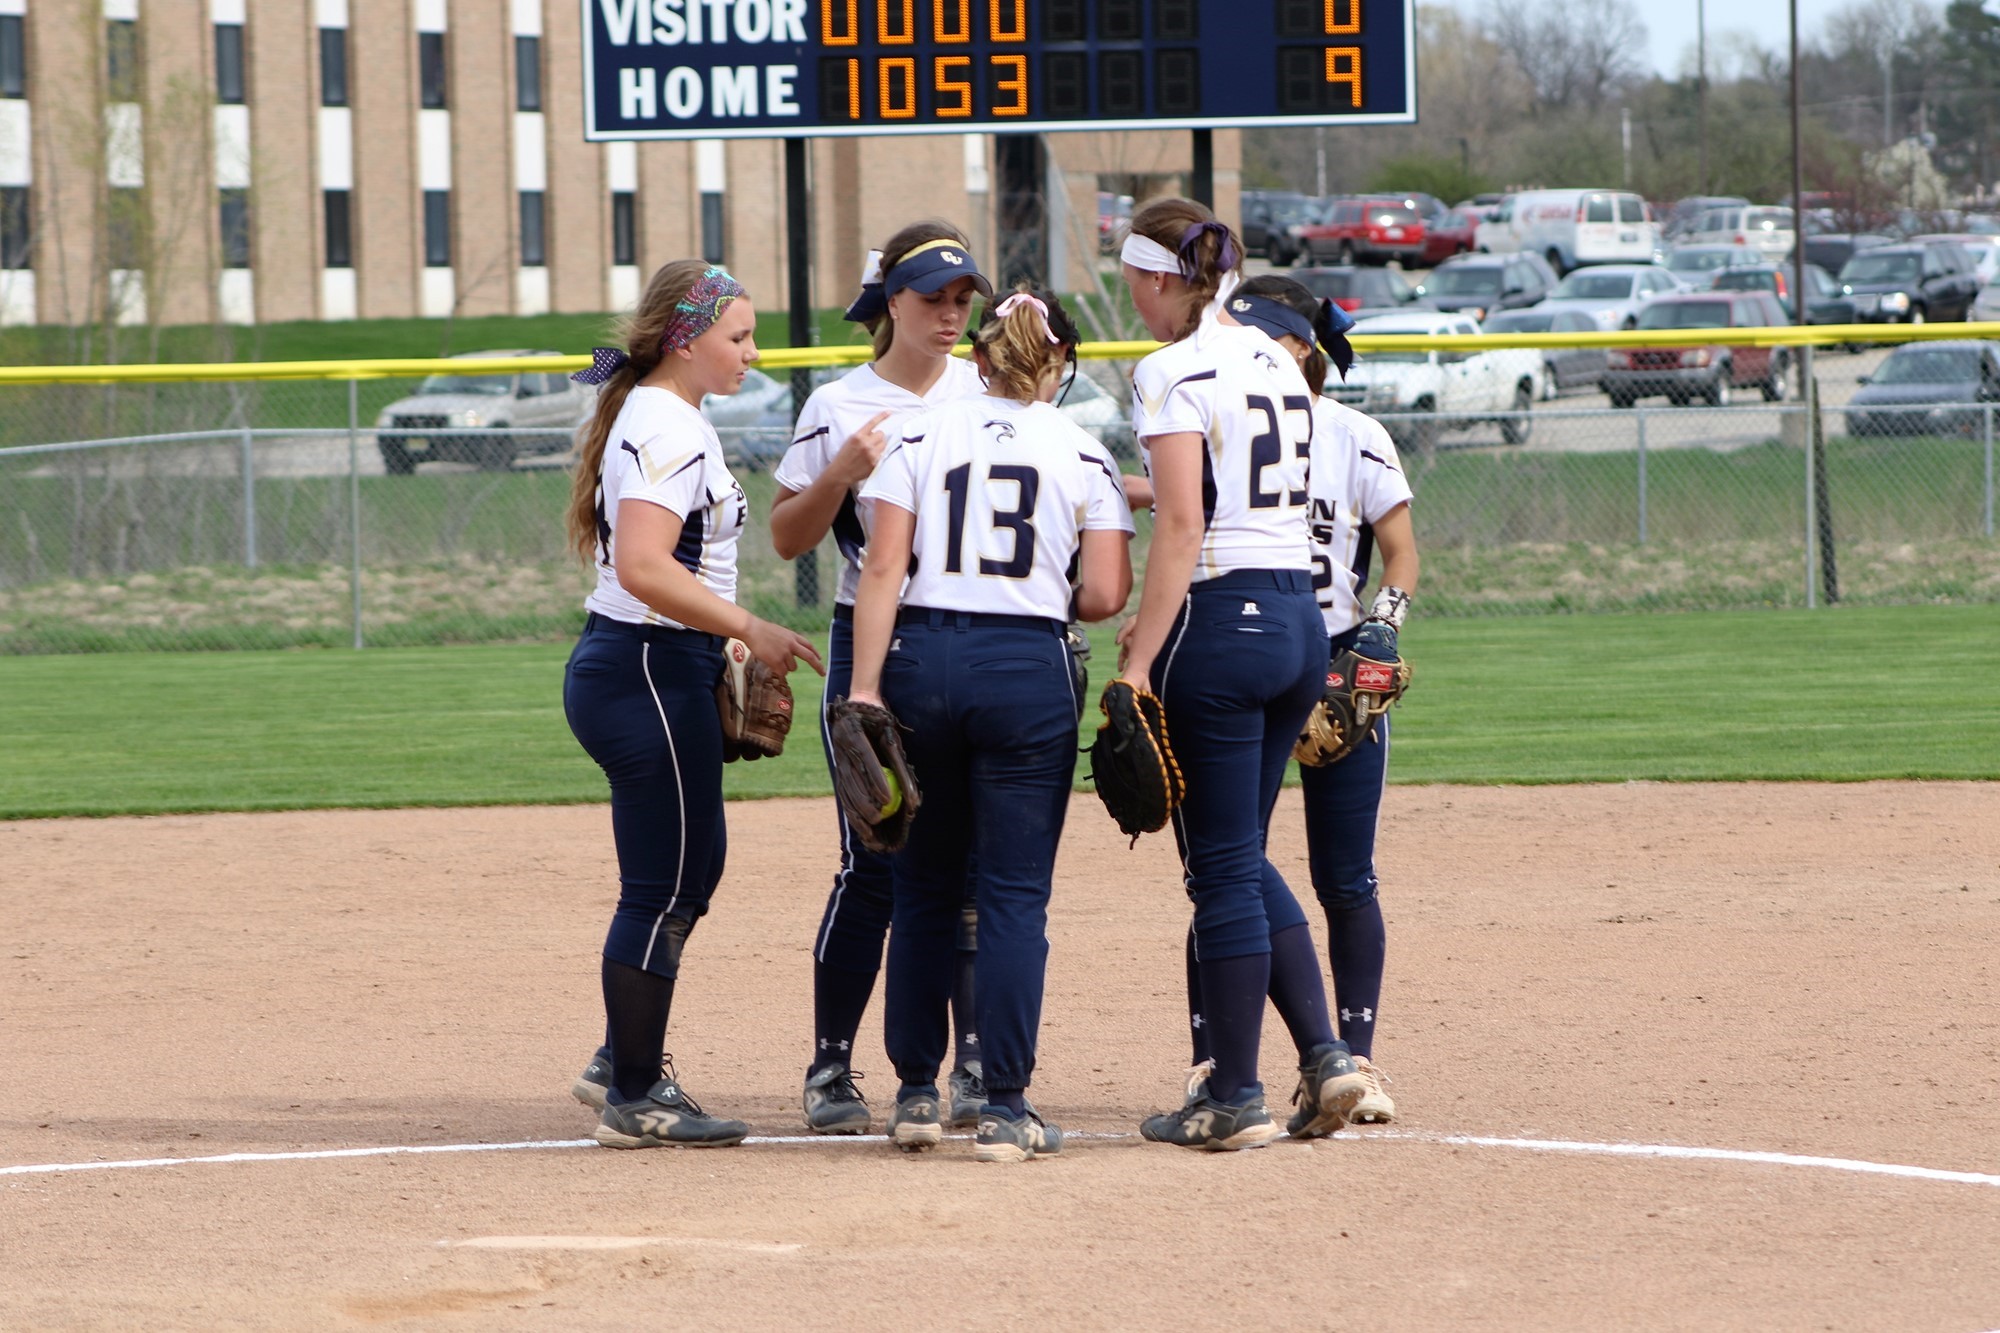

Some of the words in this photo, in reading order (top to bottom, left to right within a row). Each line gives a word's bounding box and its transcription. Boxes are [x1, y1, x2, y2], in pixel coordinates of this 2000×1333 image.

[601, 0, 807, 45] VISITOR
[620, 65, 800, 119] HOME
[1325, 47, 1361, 107] 9
[1246, 392, 1314, 509] 23
[943, 461, 1041, 580] 13
